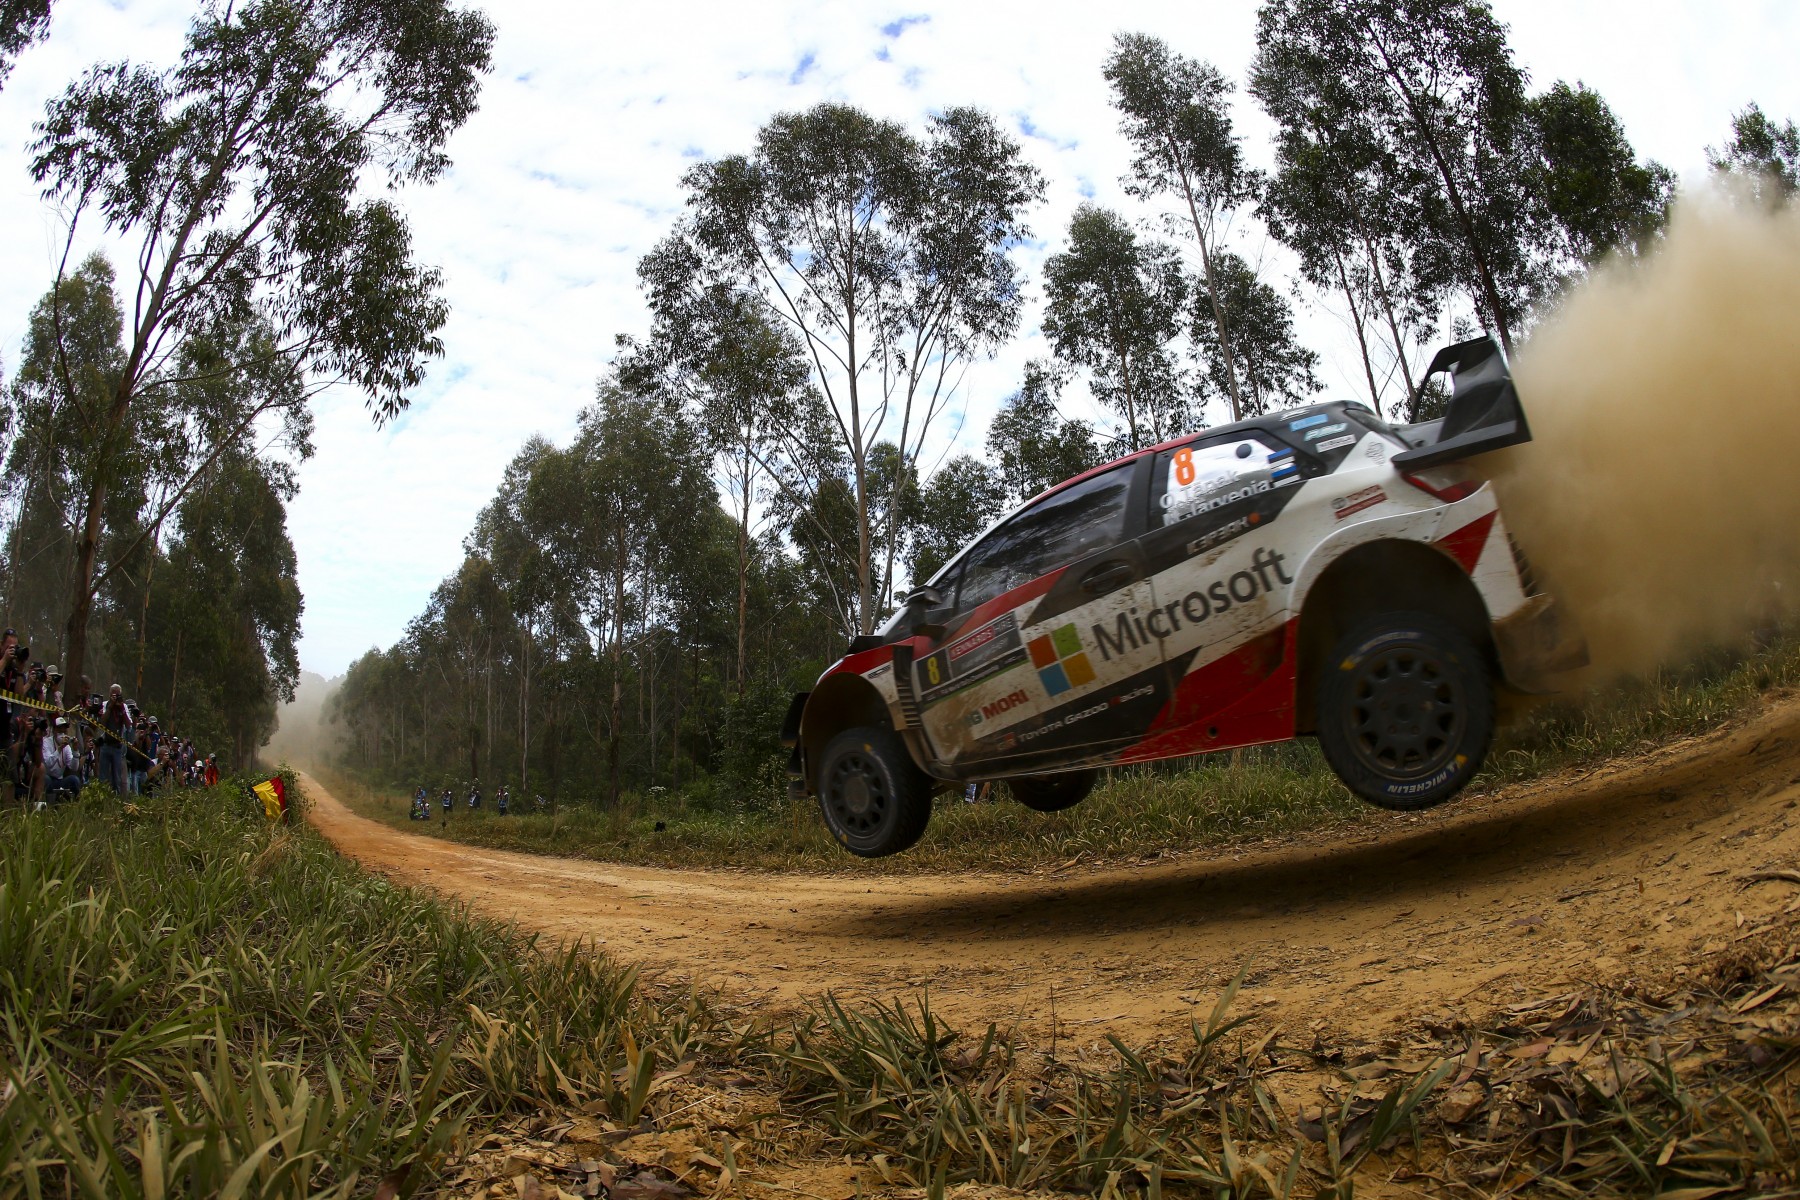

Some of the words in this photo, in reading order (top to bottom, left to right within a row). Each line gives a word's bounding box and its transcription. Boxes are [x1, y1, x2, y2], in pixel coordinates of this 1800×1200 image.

[1173, 447, 1195, 486] 8
[1092, 547, 1293, 661] Microsoft
[927, 656, 940, 685] 8
[982, 689, 1030, 720] MORI
[1018, 720, 1063, 742] TOYOTA
[1387, 771, 1447, 794] MICHELIN
